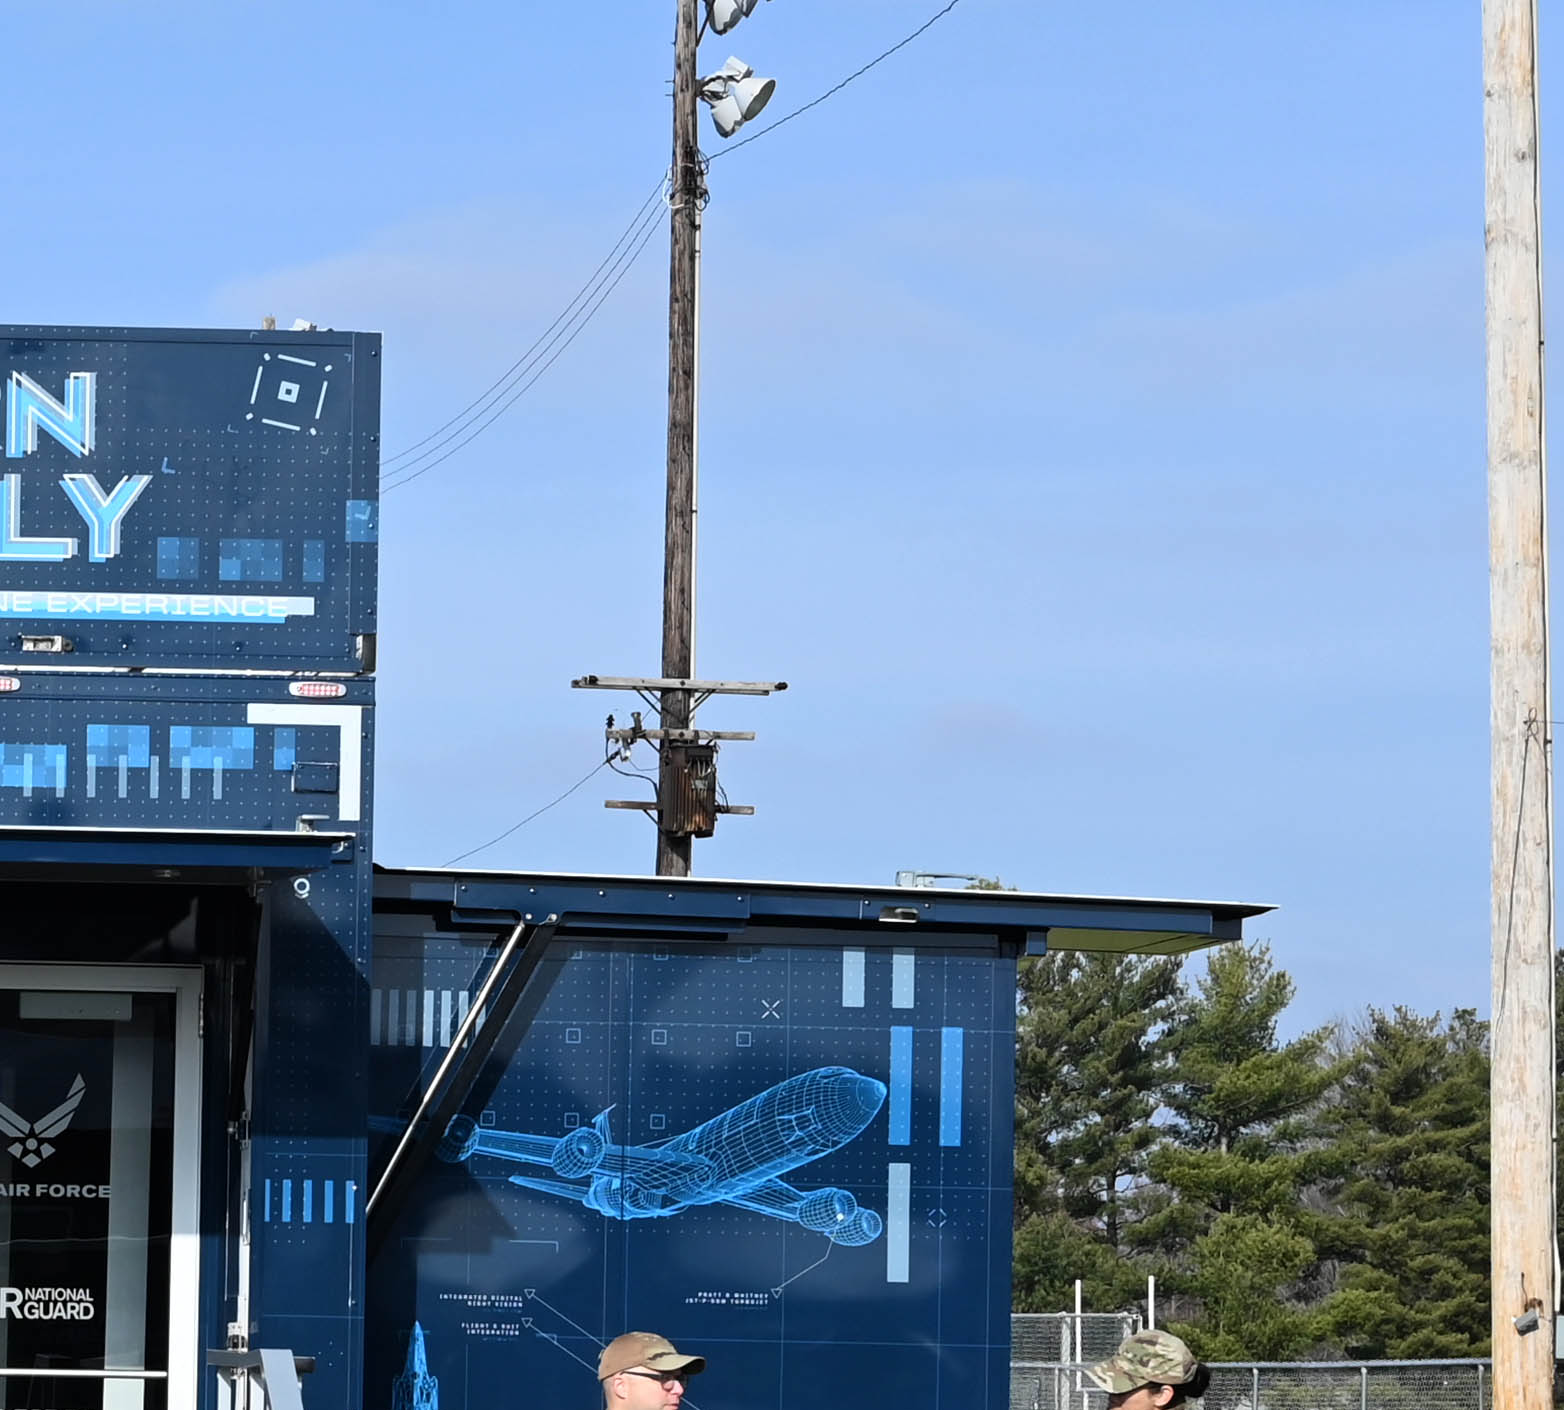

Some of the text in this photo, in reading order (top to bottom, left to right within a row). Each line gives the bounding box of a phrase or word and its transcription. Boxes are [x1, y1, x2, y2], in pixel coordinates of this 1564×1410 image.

[48, 592, 290, 616] EXPERIENCE
[36, 1184, 112, 1198] FORCE
[25, 1288, 94, 1302] NATIONAL
[23, 1302, 95, 1320] GUARD
